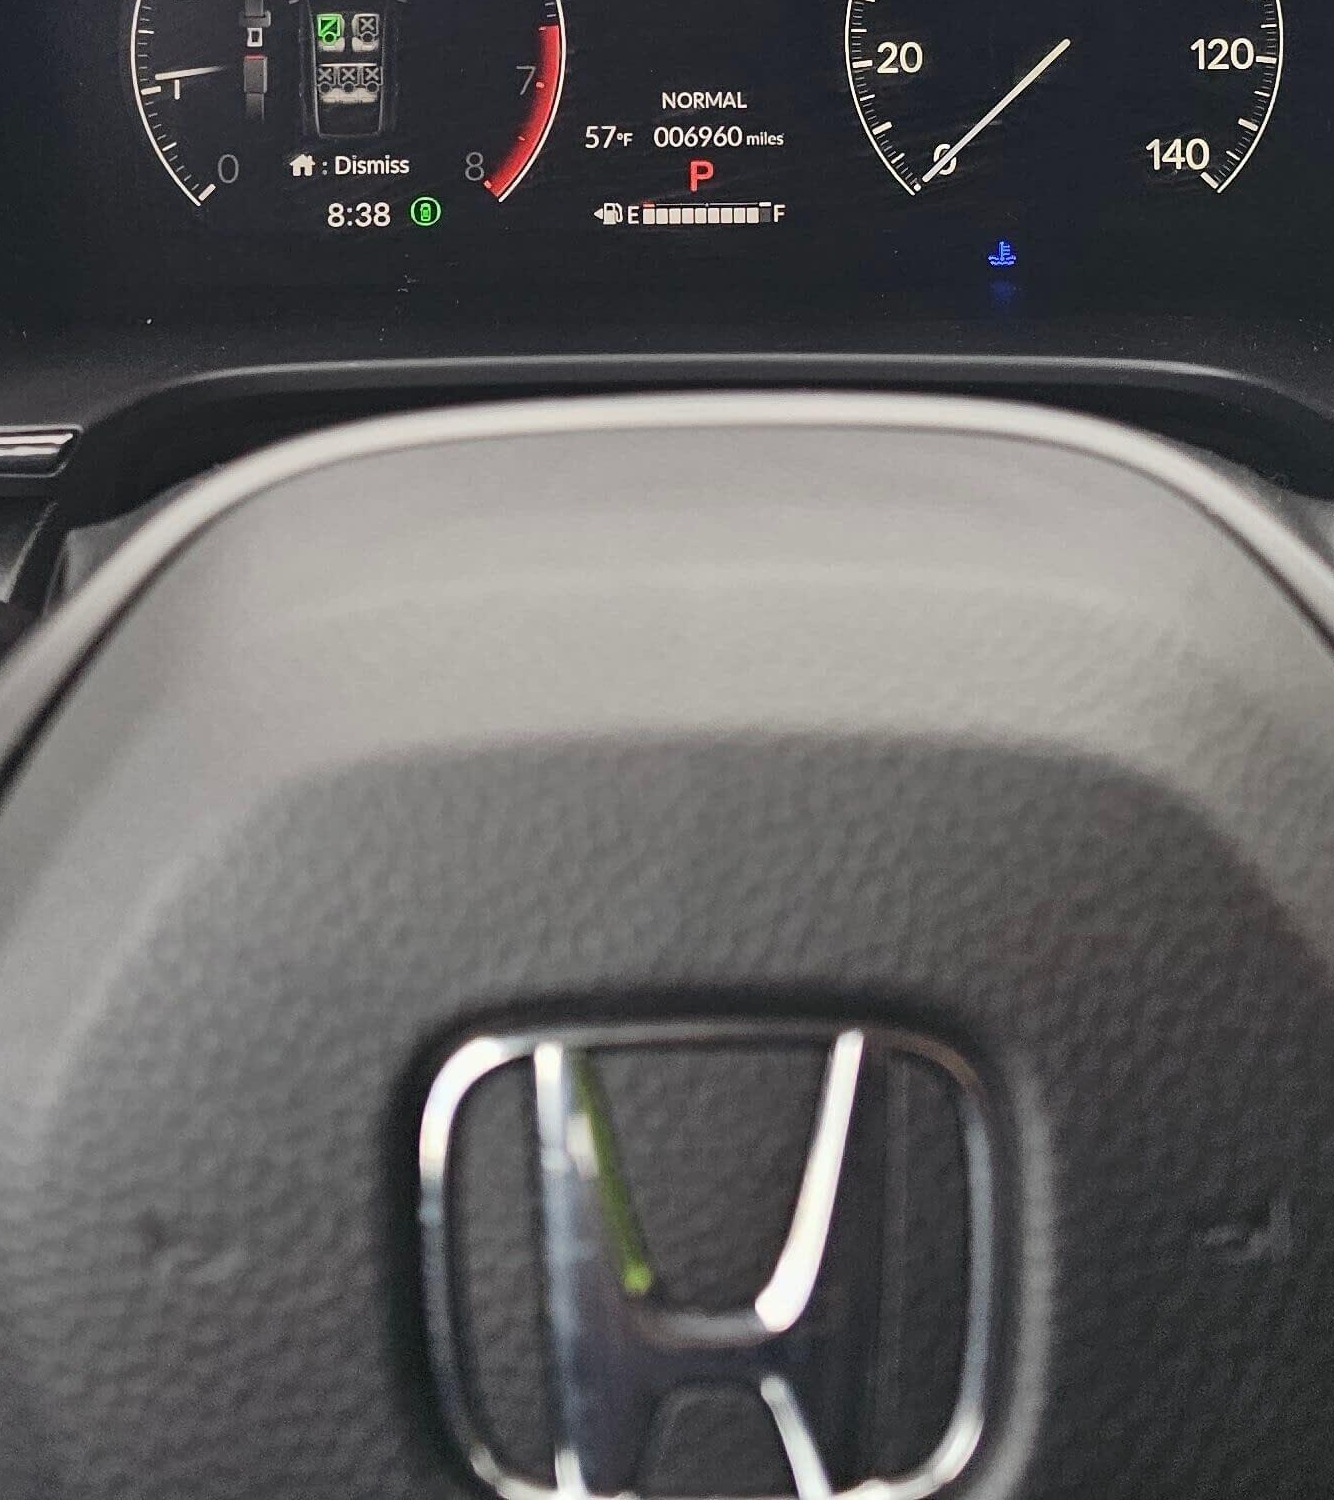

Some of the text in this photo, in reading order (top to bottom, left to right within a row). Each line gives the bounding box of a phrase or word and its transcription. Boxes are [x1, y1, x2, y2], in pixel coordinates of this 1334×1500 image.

[876, 41, 924, 75] 20
[1190, 37, 1255, 71] 120
[515, 65, 537, 97] 7
[662, 91, 748, 110] NORMAL
[653, 125, 744, 148] 006960
[746, 131, 785, 146] miles
[217, 153, 240, 185] 0
[334, 154, 410, 175] Dismiss
[464, 151, 486, 183] 8
[1145, 138, 1211, 171] 140
[690, 160, 714, 192] P
[327, 201, 391, 228] 8:38
[626, 203, 786, 225] E F
